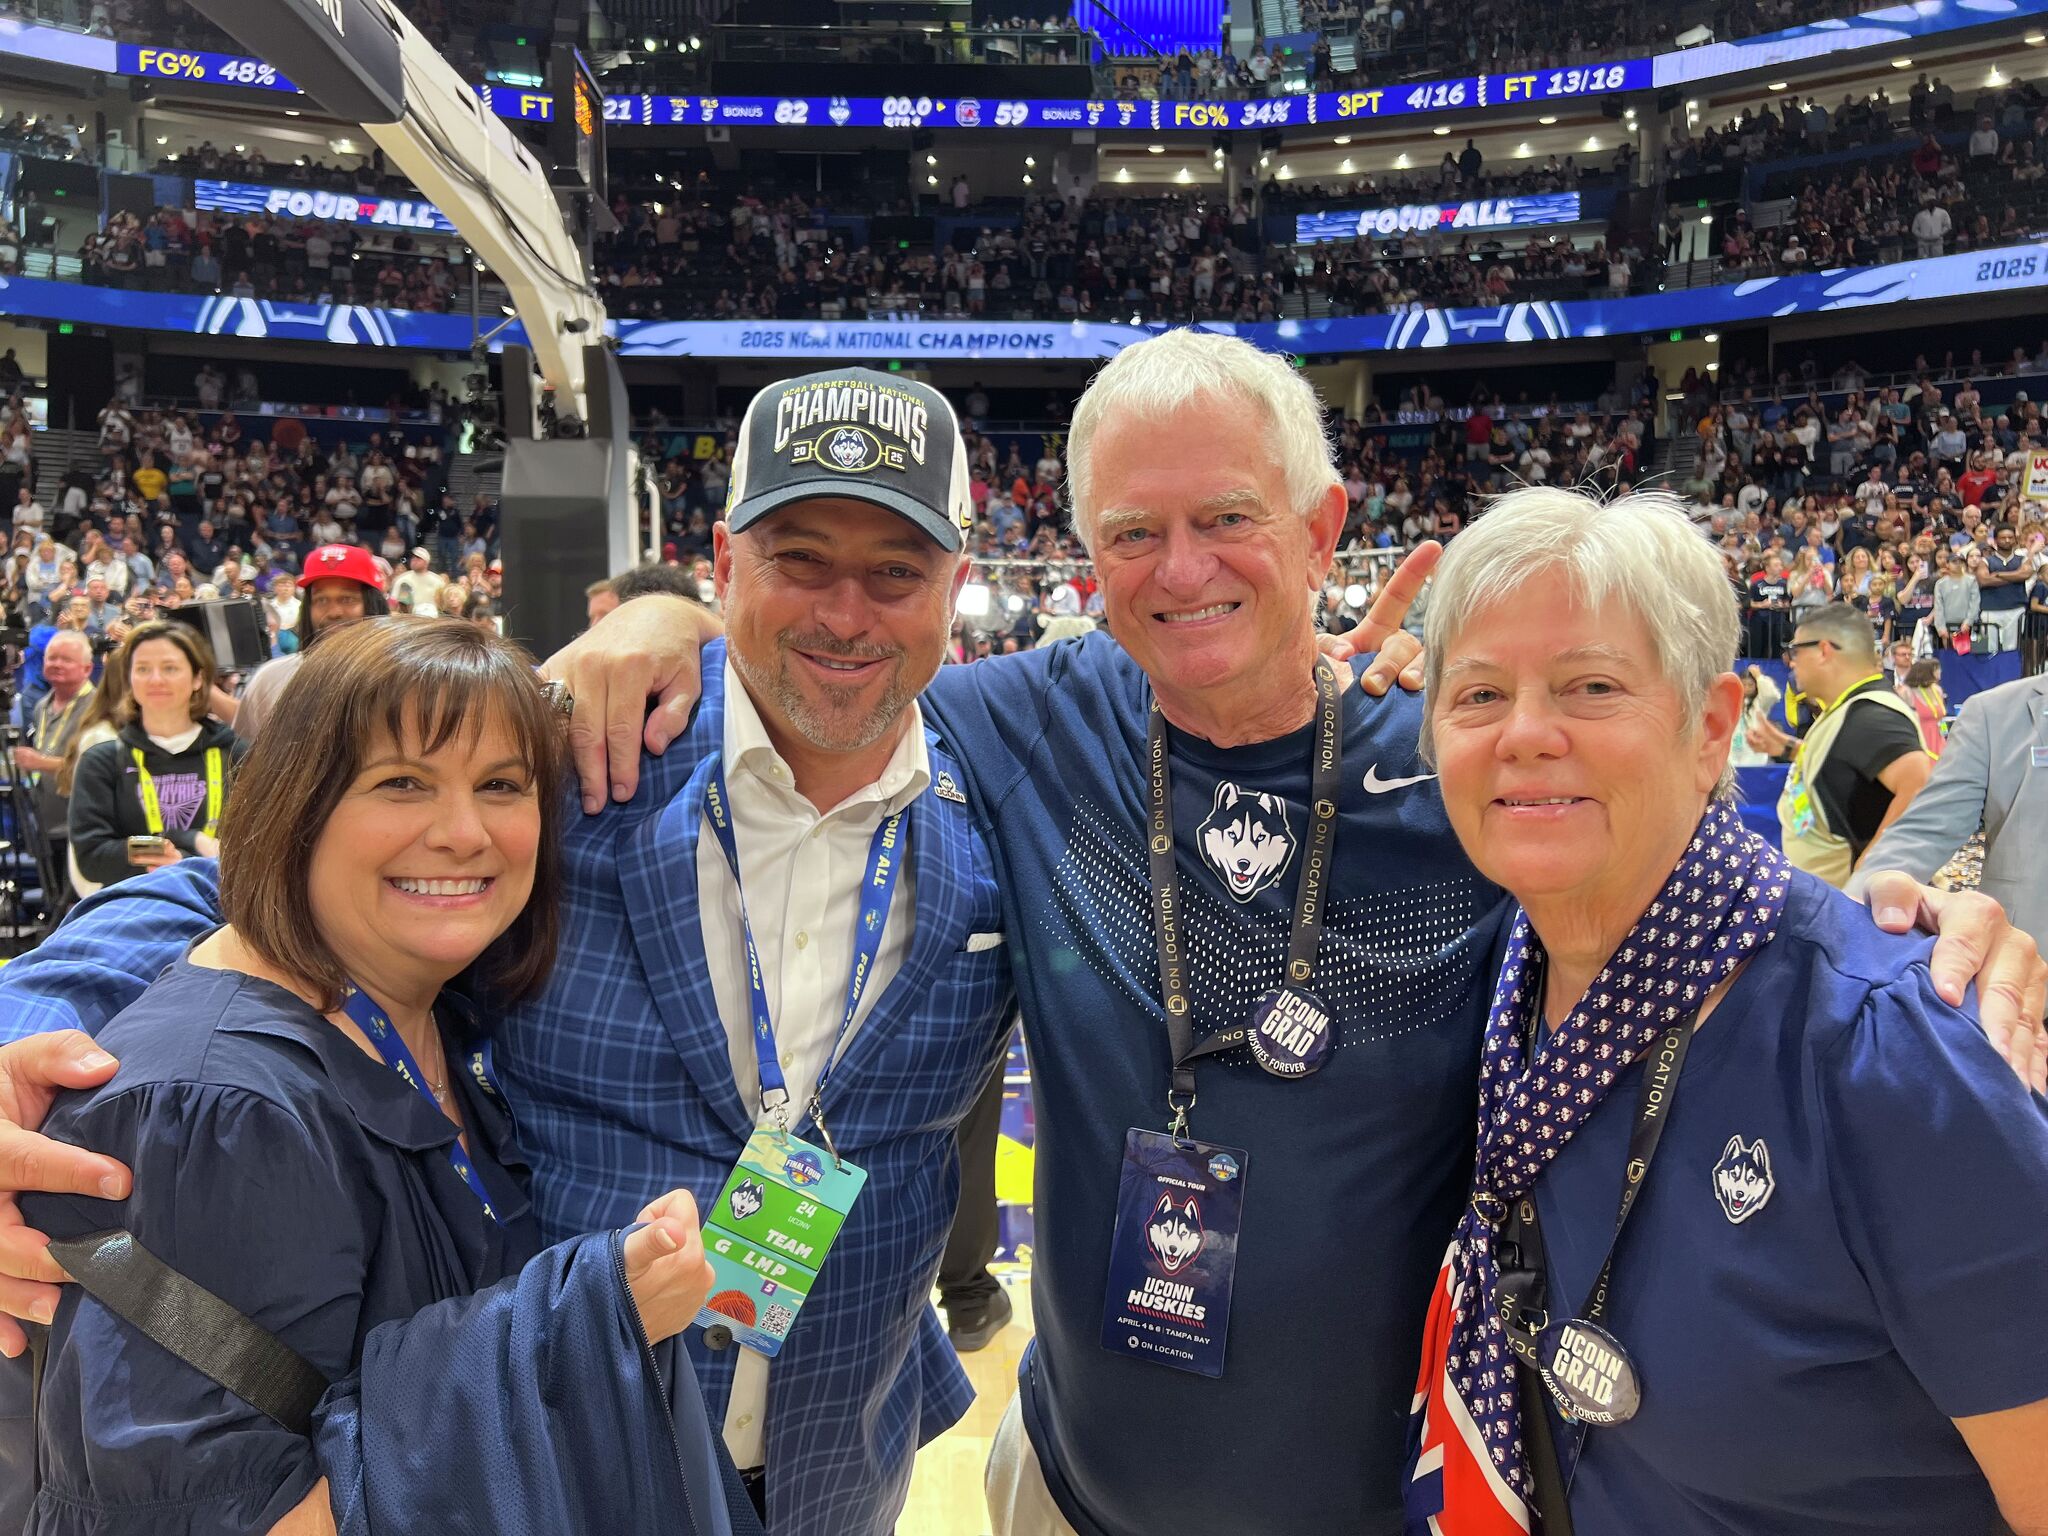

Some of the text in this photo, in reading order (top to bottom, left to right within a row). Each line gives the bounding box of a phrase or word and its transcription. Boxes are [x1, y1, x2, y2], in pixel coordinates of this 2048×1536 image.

[138, 50, 277, 86] FG% 48%
[1504, 66, 1625, 100] FT 13/18
[520, 94, 553, 118] FT
[722, 104, 763, 118] BONUS
[774, 99, 809, 124] 82
[882, 96, 932, 117] 00.0
[1336, 84, 1466, 118] 3PT 4/16
[670, 108, 684, 122] 2
[701, 109, 714, 122] 5
[994, 102, 1029, 125] 59
[1042, 107, 1082, 121] BONUS
[1087, 111, 1100, 125] 5
[1118, 112, 1131, 126] 3
[1174, 101, 1292, 126] FG% 34%
[264, 188, 358, 221] FOUR
[371, 200, 436, 229] ALL
[1355, 204, 1442, 235] FOUR
[1451, 200, 1514, 228] ALL
[1975, 256, 2038, 282] 2025
[741, 331, 783, 349] 2025
[835, 331, 913, 349] NATIONAL
[917, 333, 1055, 349] CHAMPIONS
[782, 380, 926, 409] NCAA BASKETBALL NATIONAL
[773, 387, 928, 466] CHAMPIONS
[793, 446, 807, 458] 20
[890, 451, 903, 463] 25
[1322, 683, 1334, 701] ON
[936, 788, 965, 801] UCONN
[1154, 811, 1164, 830] ON
[1315, 824, 1327, 845] ON
[873, 854, 891, 886] ALL
[852, 952, 869, 1001] FOUR
[1169, 966, 1181, 990] ON
[1275, 989, 1330, 1035] UCONN
[1260, 1008, 1316, 1057] GRAD
[1246, 1028, 1306, 1073] HUSKIES FOREVER
[785, 1159, 822, 1181] FINAL FOUR
[1209, 1162, 1223, 1171] FINAL
[1157, 1175, 1206, 1192] OFFICIAL TOUR
[795, 1200, 818, 1218] 24
[1619, 1190, 1632, 1216] ON
[788, 1215, 812, 1230] UCONN
[715, 1238, 733, 1254] G
[765, 1228, 814, 1259] TEAM
[1143, 1276, 1194, 1303] UCONN
[1127, 1289, 1207, 1321] HUSKIES
[1117, 1316, 1141, 1328] APRIL
[1141, 1322, 1148, 1330] 4
[1165, 1328, 1193, 1342] TAMPA
[1193, 1335, 1211, 1345] BAY
[1141, 1341, 1194, 1361] ON LOCATION
[1560, 1325, 1624, 1382] UCONN
[1552, 1348, 1613, 1406] GRAD
[1540, 1367, 1615, 1423] HUSKIES FOREVER
